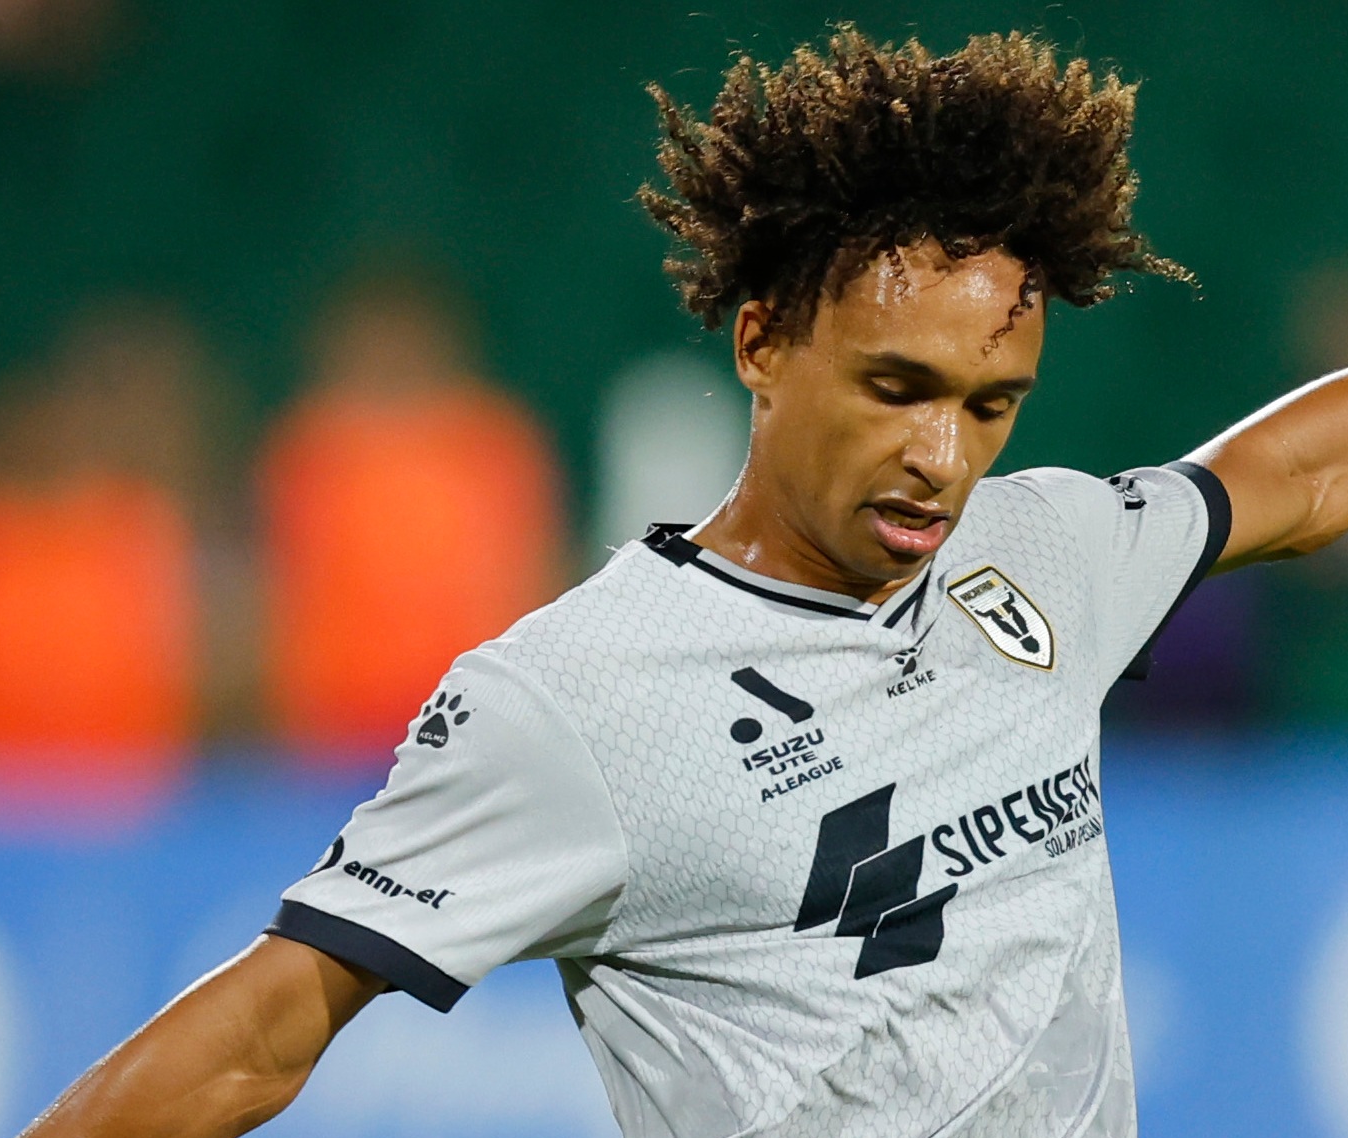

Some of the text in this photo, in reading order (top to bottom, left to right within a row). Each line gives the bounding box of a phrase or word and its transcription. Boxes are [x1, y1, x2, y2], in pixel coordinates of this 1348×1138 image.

[886, 669, 937, 699] KELME
[419, 731, 447, 744] KELME
[742, 728, 825, 772] ISUZU
[768, 750, 819, 775] UTE
[761, 756, 843, 802] A-LEAGUE
